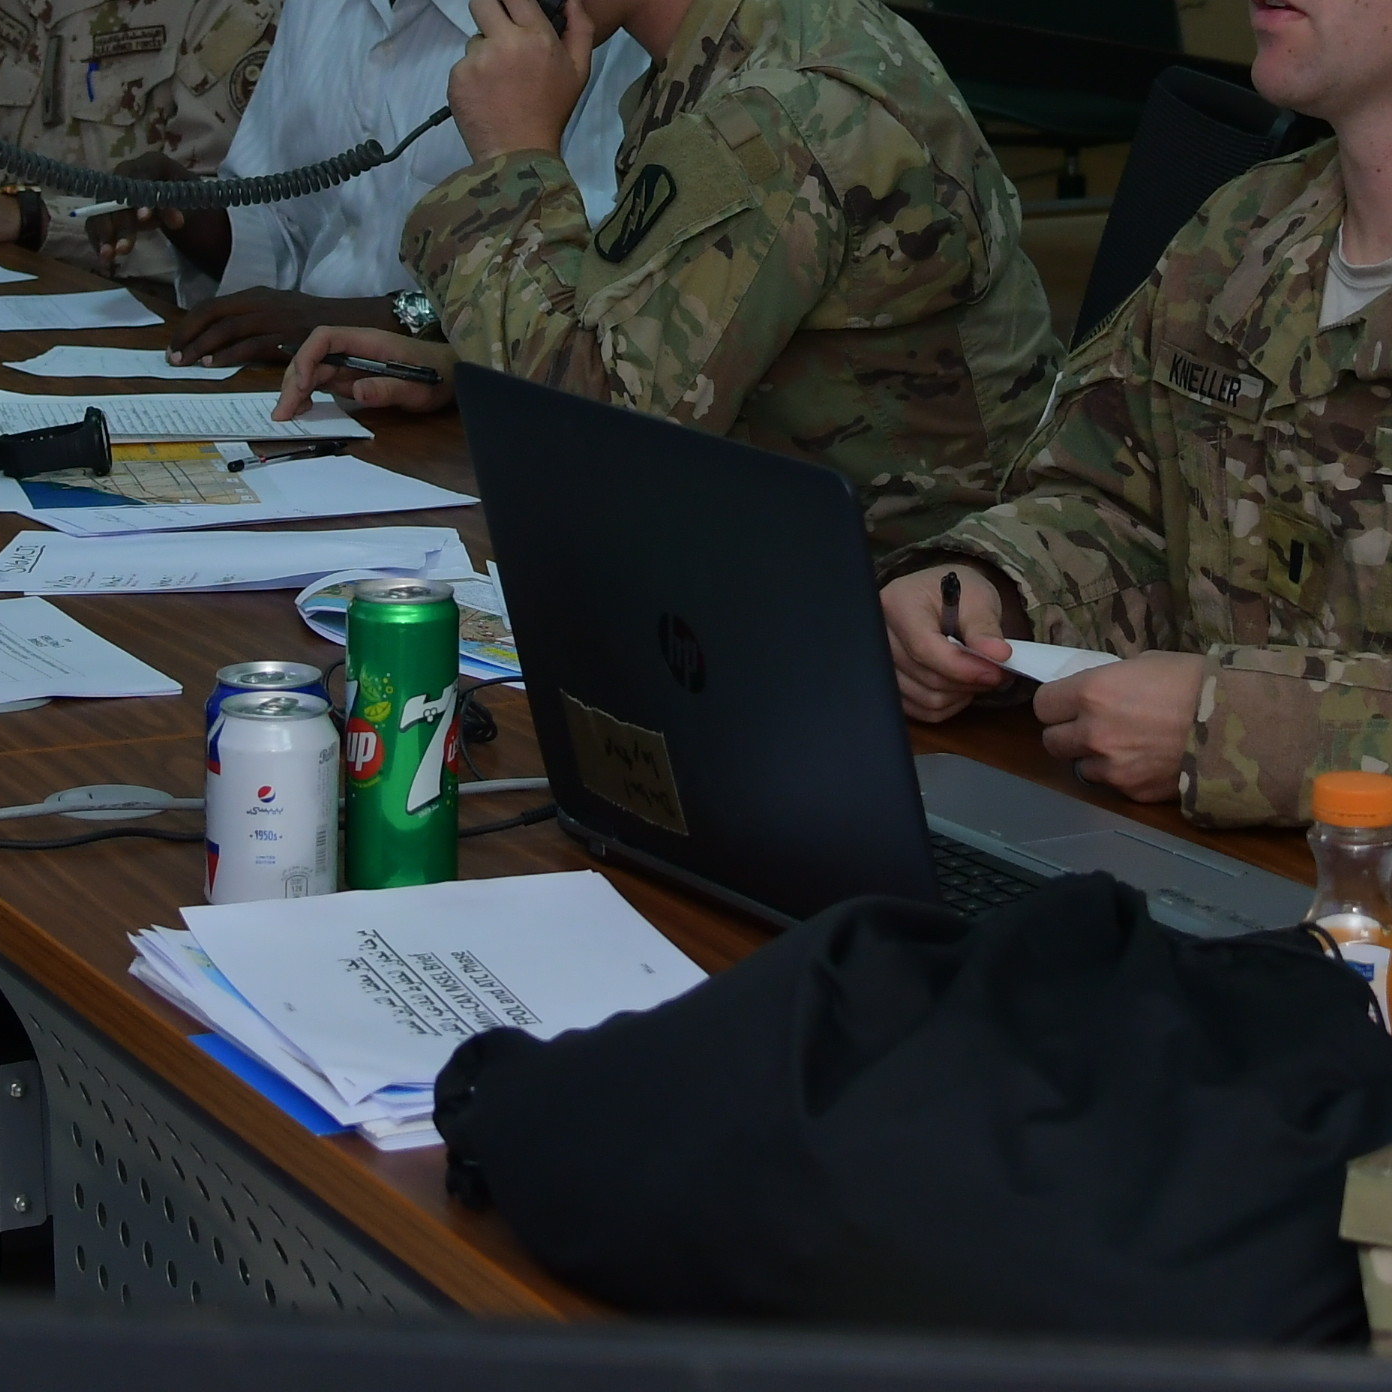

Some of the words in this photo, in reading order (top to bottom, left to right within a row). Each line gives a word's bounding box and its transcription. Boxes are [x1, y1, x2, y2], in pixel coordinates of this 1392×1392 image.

[1168, 353, 1242, 408] KNELLER
[408, 952, 442, 973] Brief
[450, 950, 482, 974] Phase
[430, 971, 462, 994] MSEL
[468, 973, 498, 990] ATC
[486, 988, 516, 1006] and
